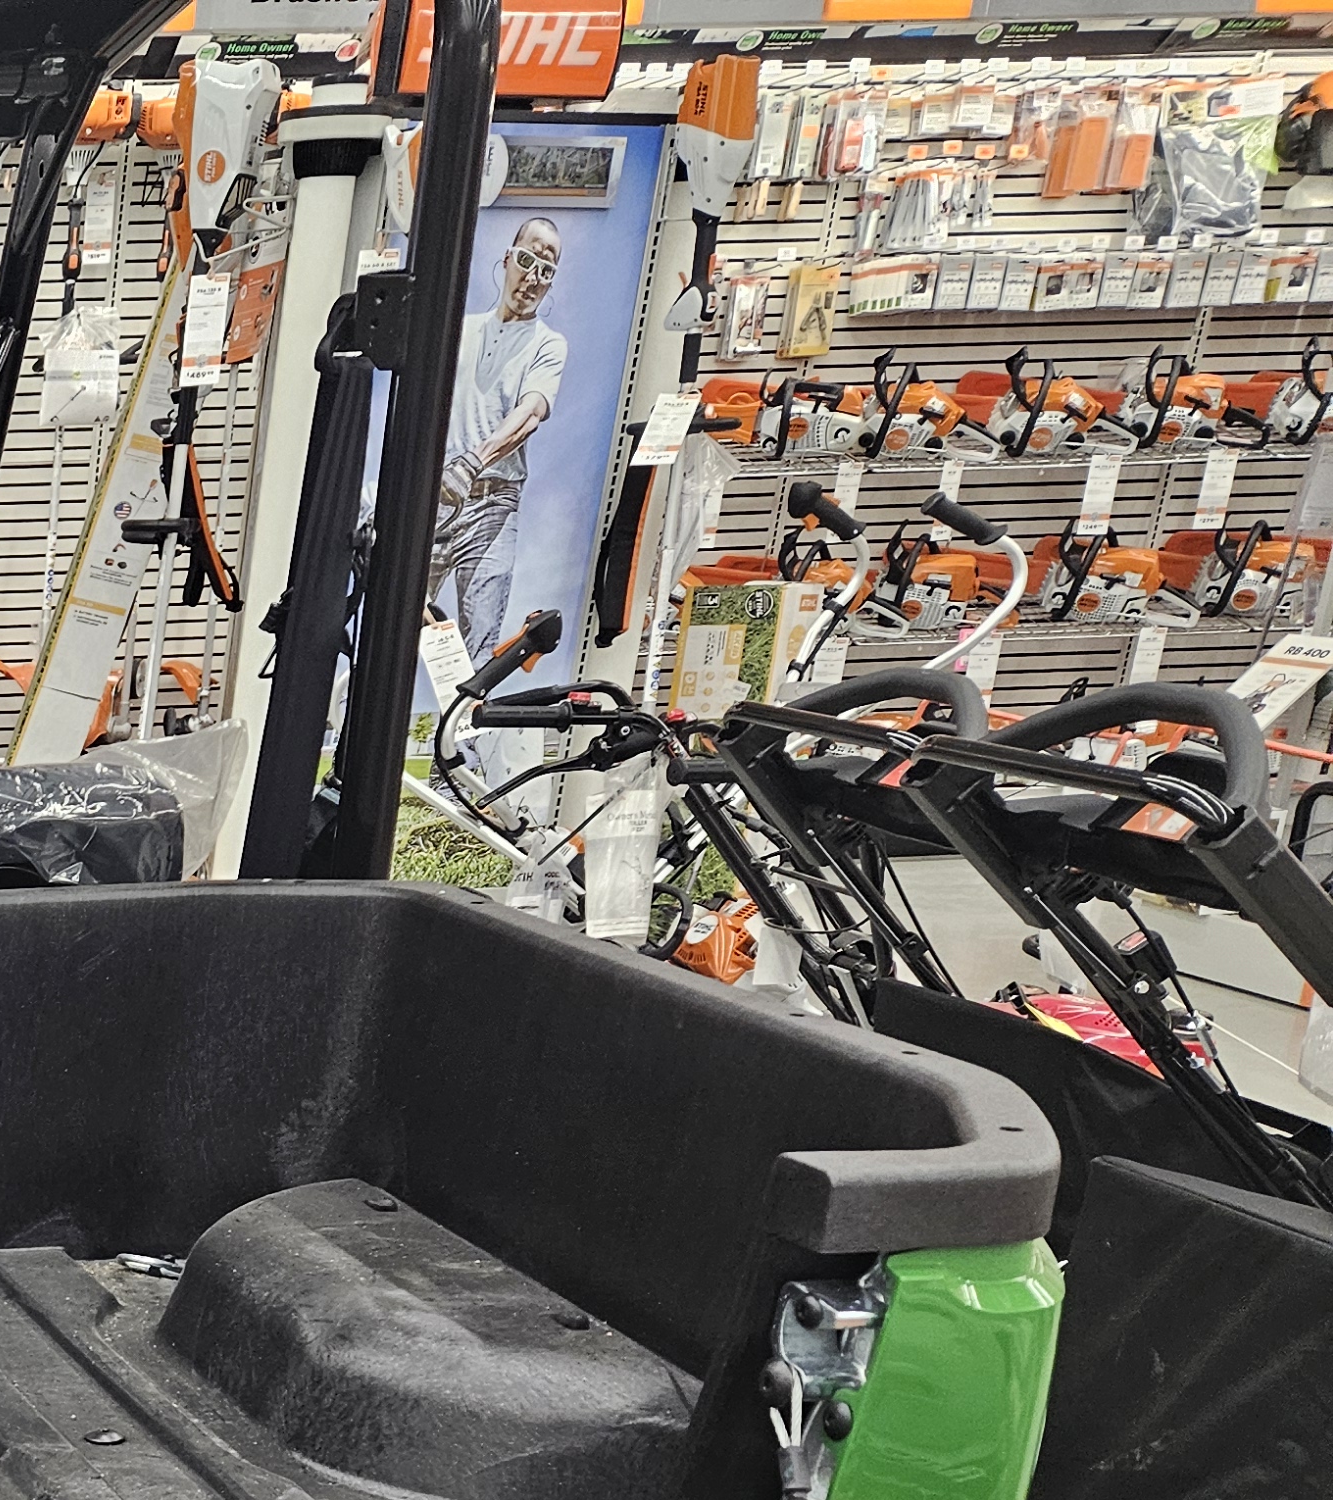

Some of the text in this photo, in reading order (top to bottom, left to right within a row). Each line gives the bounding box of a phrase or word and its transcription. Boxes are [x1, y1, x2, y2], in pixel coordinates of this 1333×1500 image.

[1008, 21, 1074, 33] Home Owner
[768, 31, 798, 40] Home
[227, 43, 294, 53] Home Owner
[1284, 646, 1331, 659] RB 400
